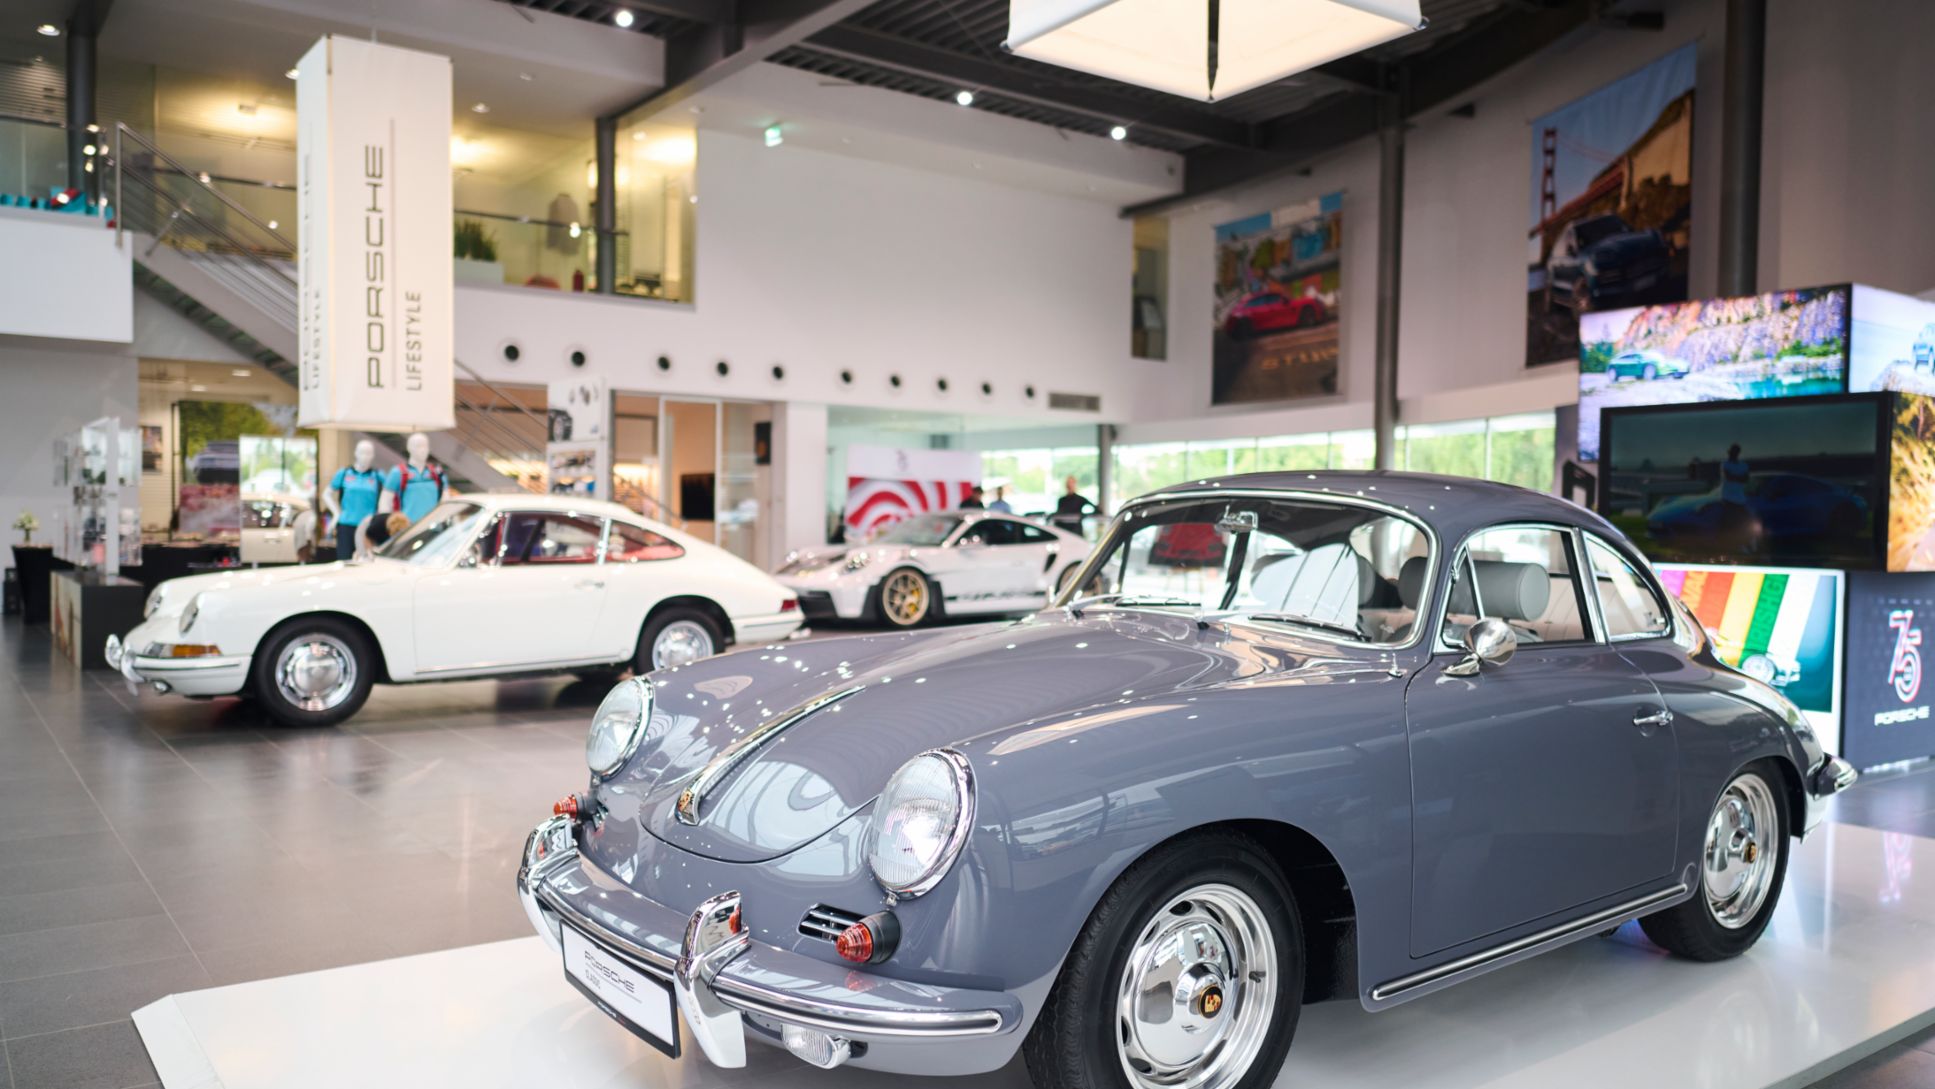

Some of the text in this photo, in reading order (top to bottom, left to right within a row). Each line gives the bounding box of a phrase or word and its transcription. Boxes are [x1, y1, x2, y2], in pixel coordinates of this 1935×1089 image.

[365, 145, 385, 389] PORSCHE
[406, 291, 423, 391] LIFESTYLE
[584, 950, 635, 993] PORSCHE
